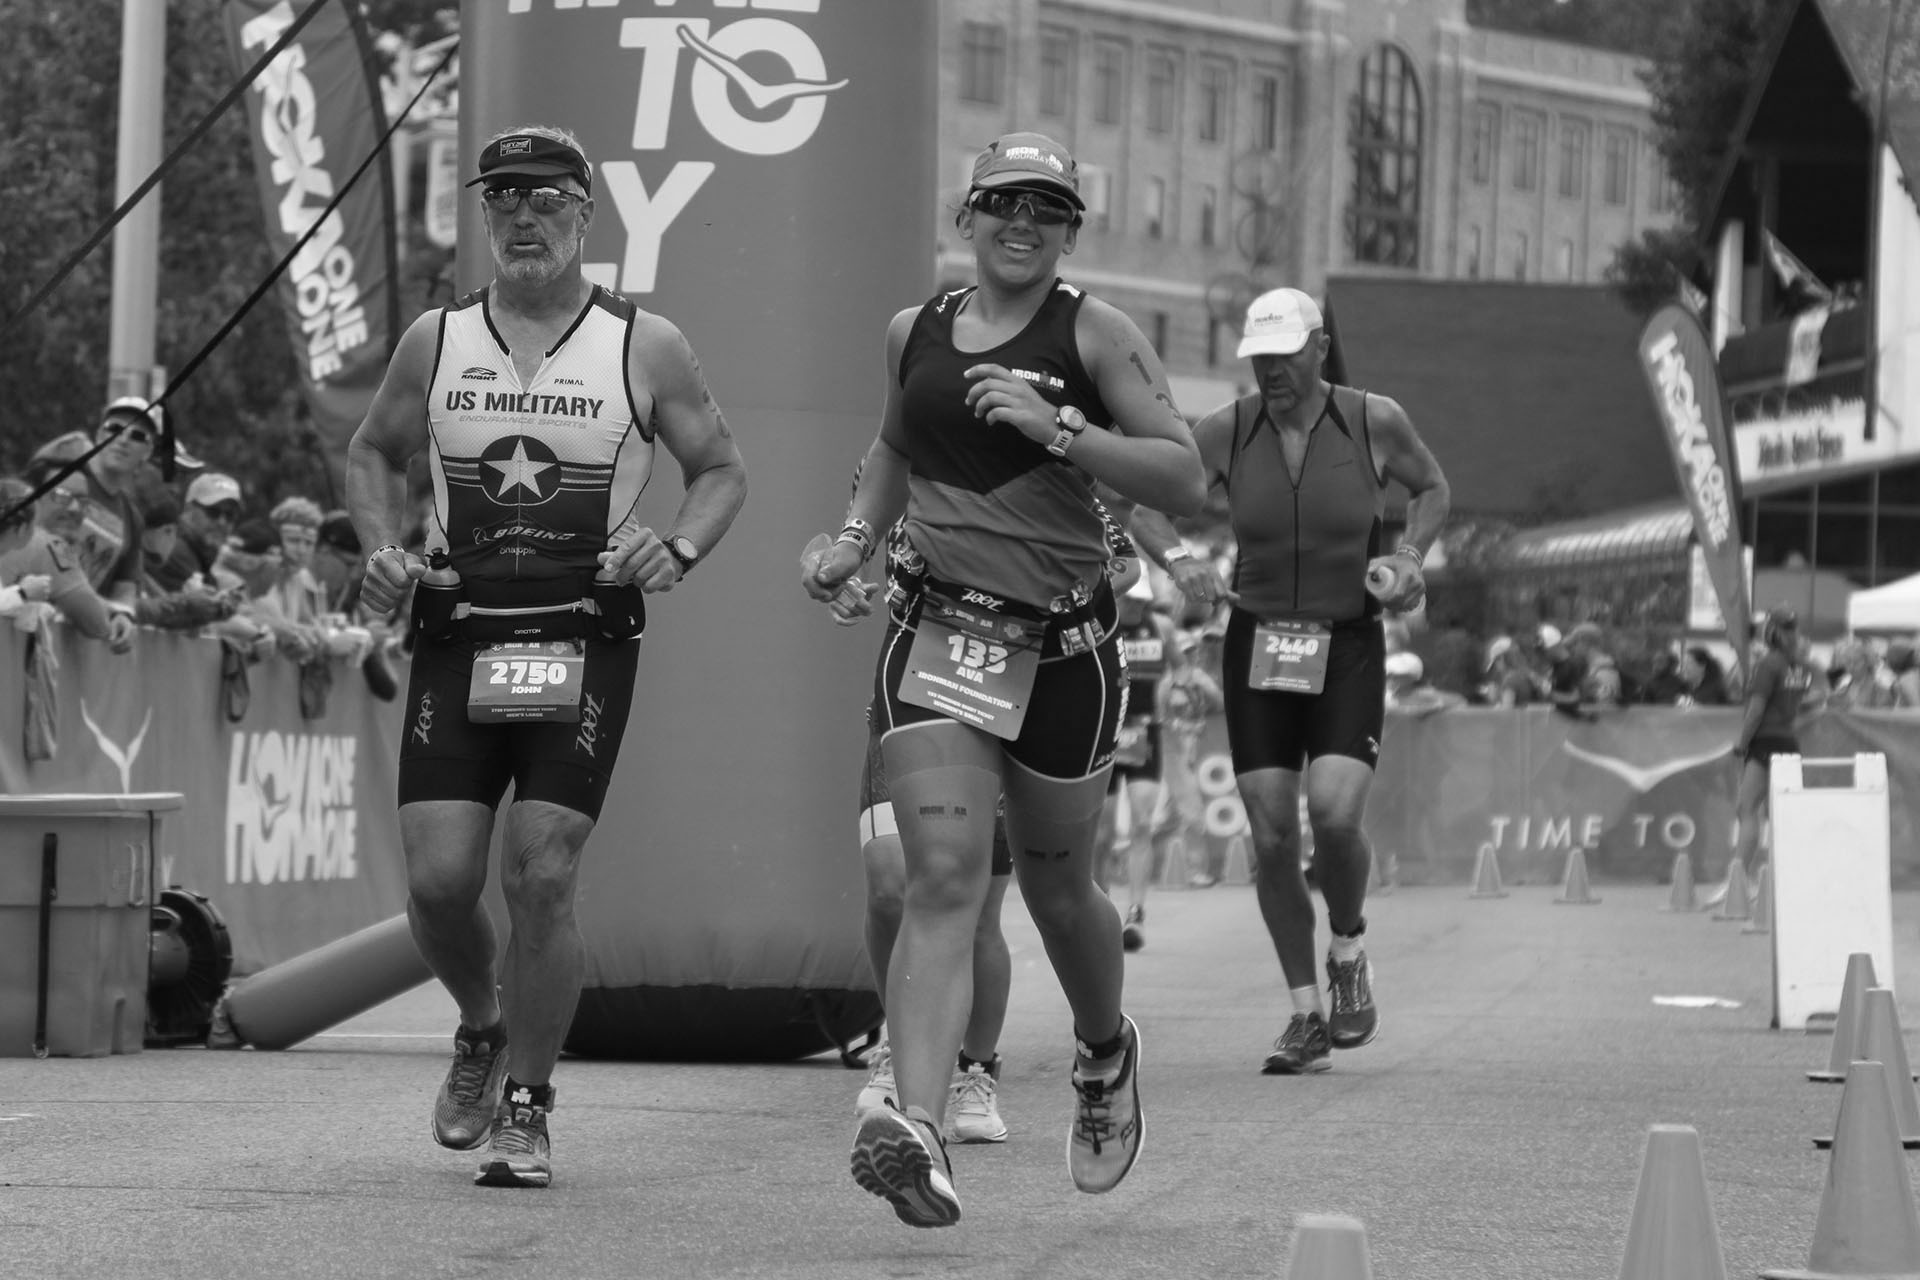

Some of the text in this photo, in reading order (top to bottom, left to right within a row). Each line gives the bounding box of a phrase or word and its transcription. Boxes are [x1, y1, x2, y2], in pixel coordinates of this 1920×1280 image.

[620, 18, 828, 155] TO
[241, 0, 343, 284] HOKA
[324, 245, 368, 352] ONE
[296, 273, 342, 381] ONE
[446, 391, 604, 419] US MILITARY
[459, 415, 587, 430] ENDURANCE SPORTS
[494, 526, 576, 540] BOEING
[948, 634, 1008, 674] 133
[1266, 635, 1319, 656] 2440
[489, 661, 567, 685] 2750
[955, 666, 984, 684] AVA
[510, 686, 542, 694] JOHN
[959, 684, 1013, 711] FOUNDATION
[1491, 815, 1603, 850] TIME
[1633, 814, 1696, 849] TO
